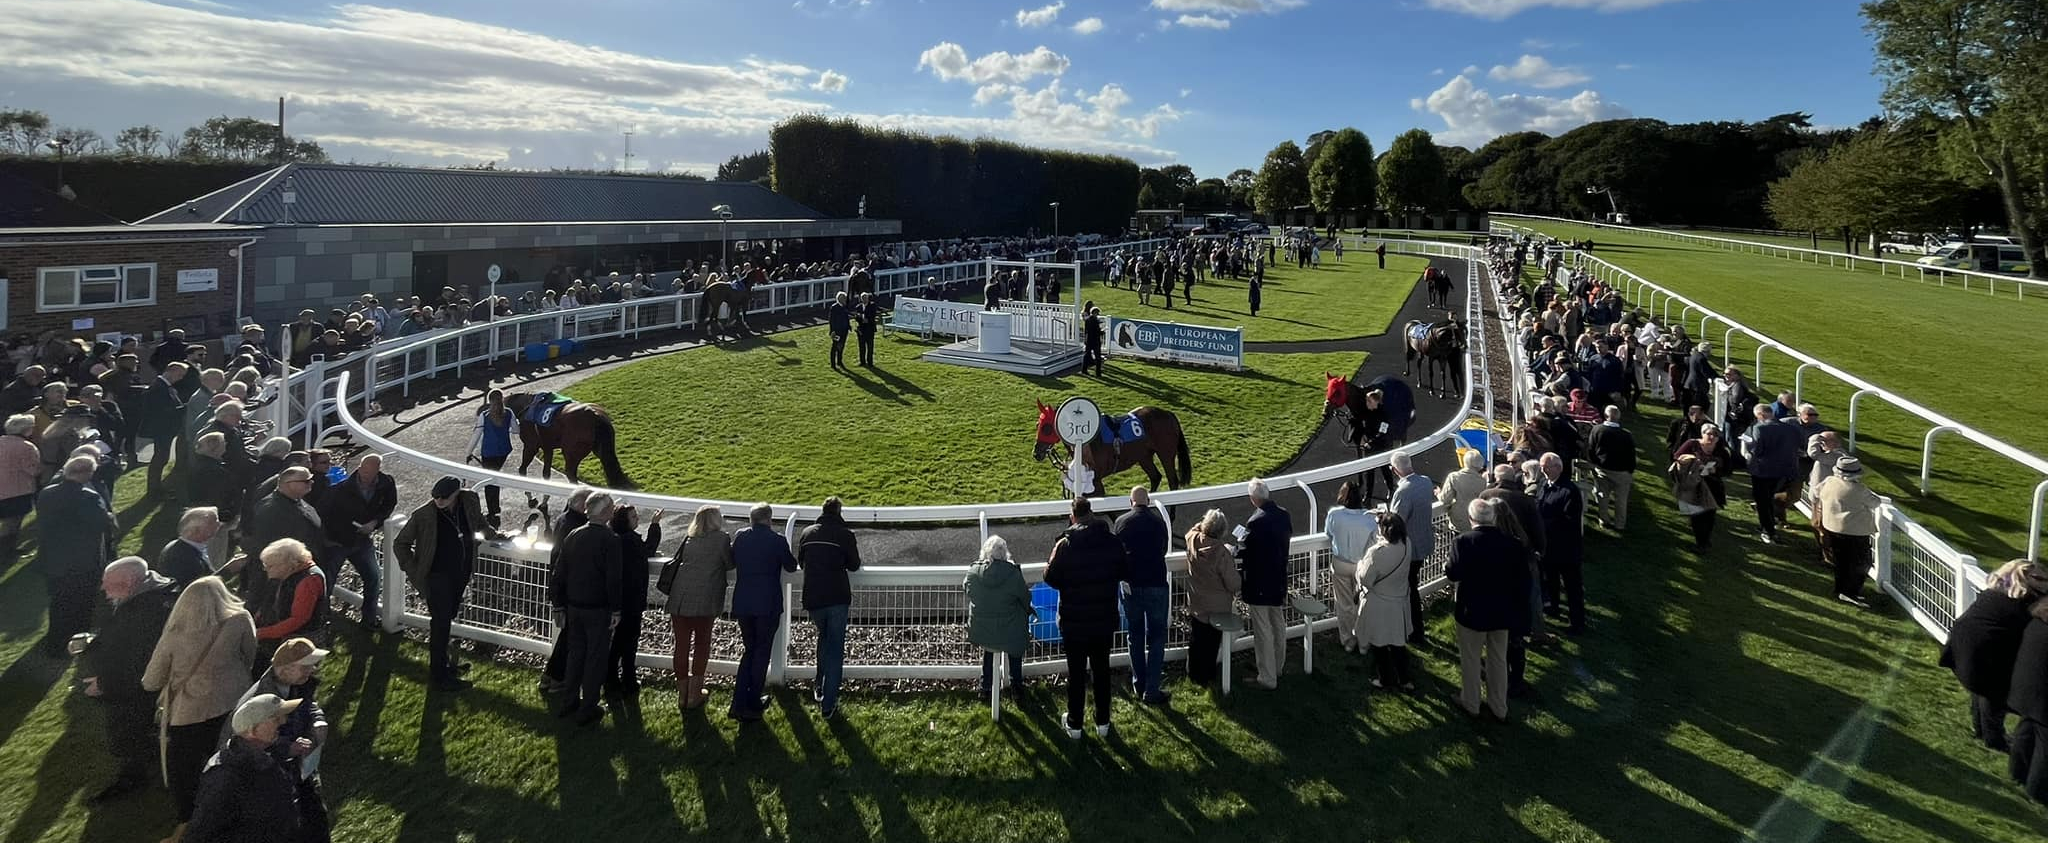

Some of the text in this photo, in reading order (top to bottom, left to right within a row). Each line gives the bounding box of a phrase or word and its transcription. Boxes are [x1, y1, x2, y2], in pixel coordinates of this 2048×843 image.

[1138, 330, 1159, 342] EBF
[1174, 327, 1226, 341] EUROPEAN
[1163, 337, 1206, 349] BREEDERS'
[1208, 342, 1234, 352] FUND
[542, 408, 551, 423] 8
[1067, 420, 1091, 438] 3rd
[1131, 421, 1142, 437] 6
